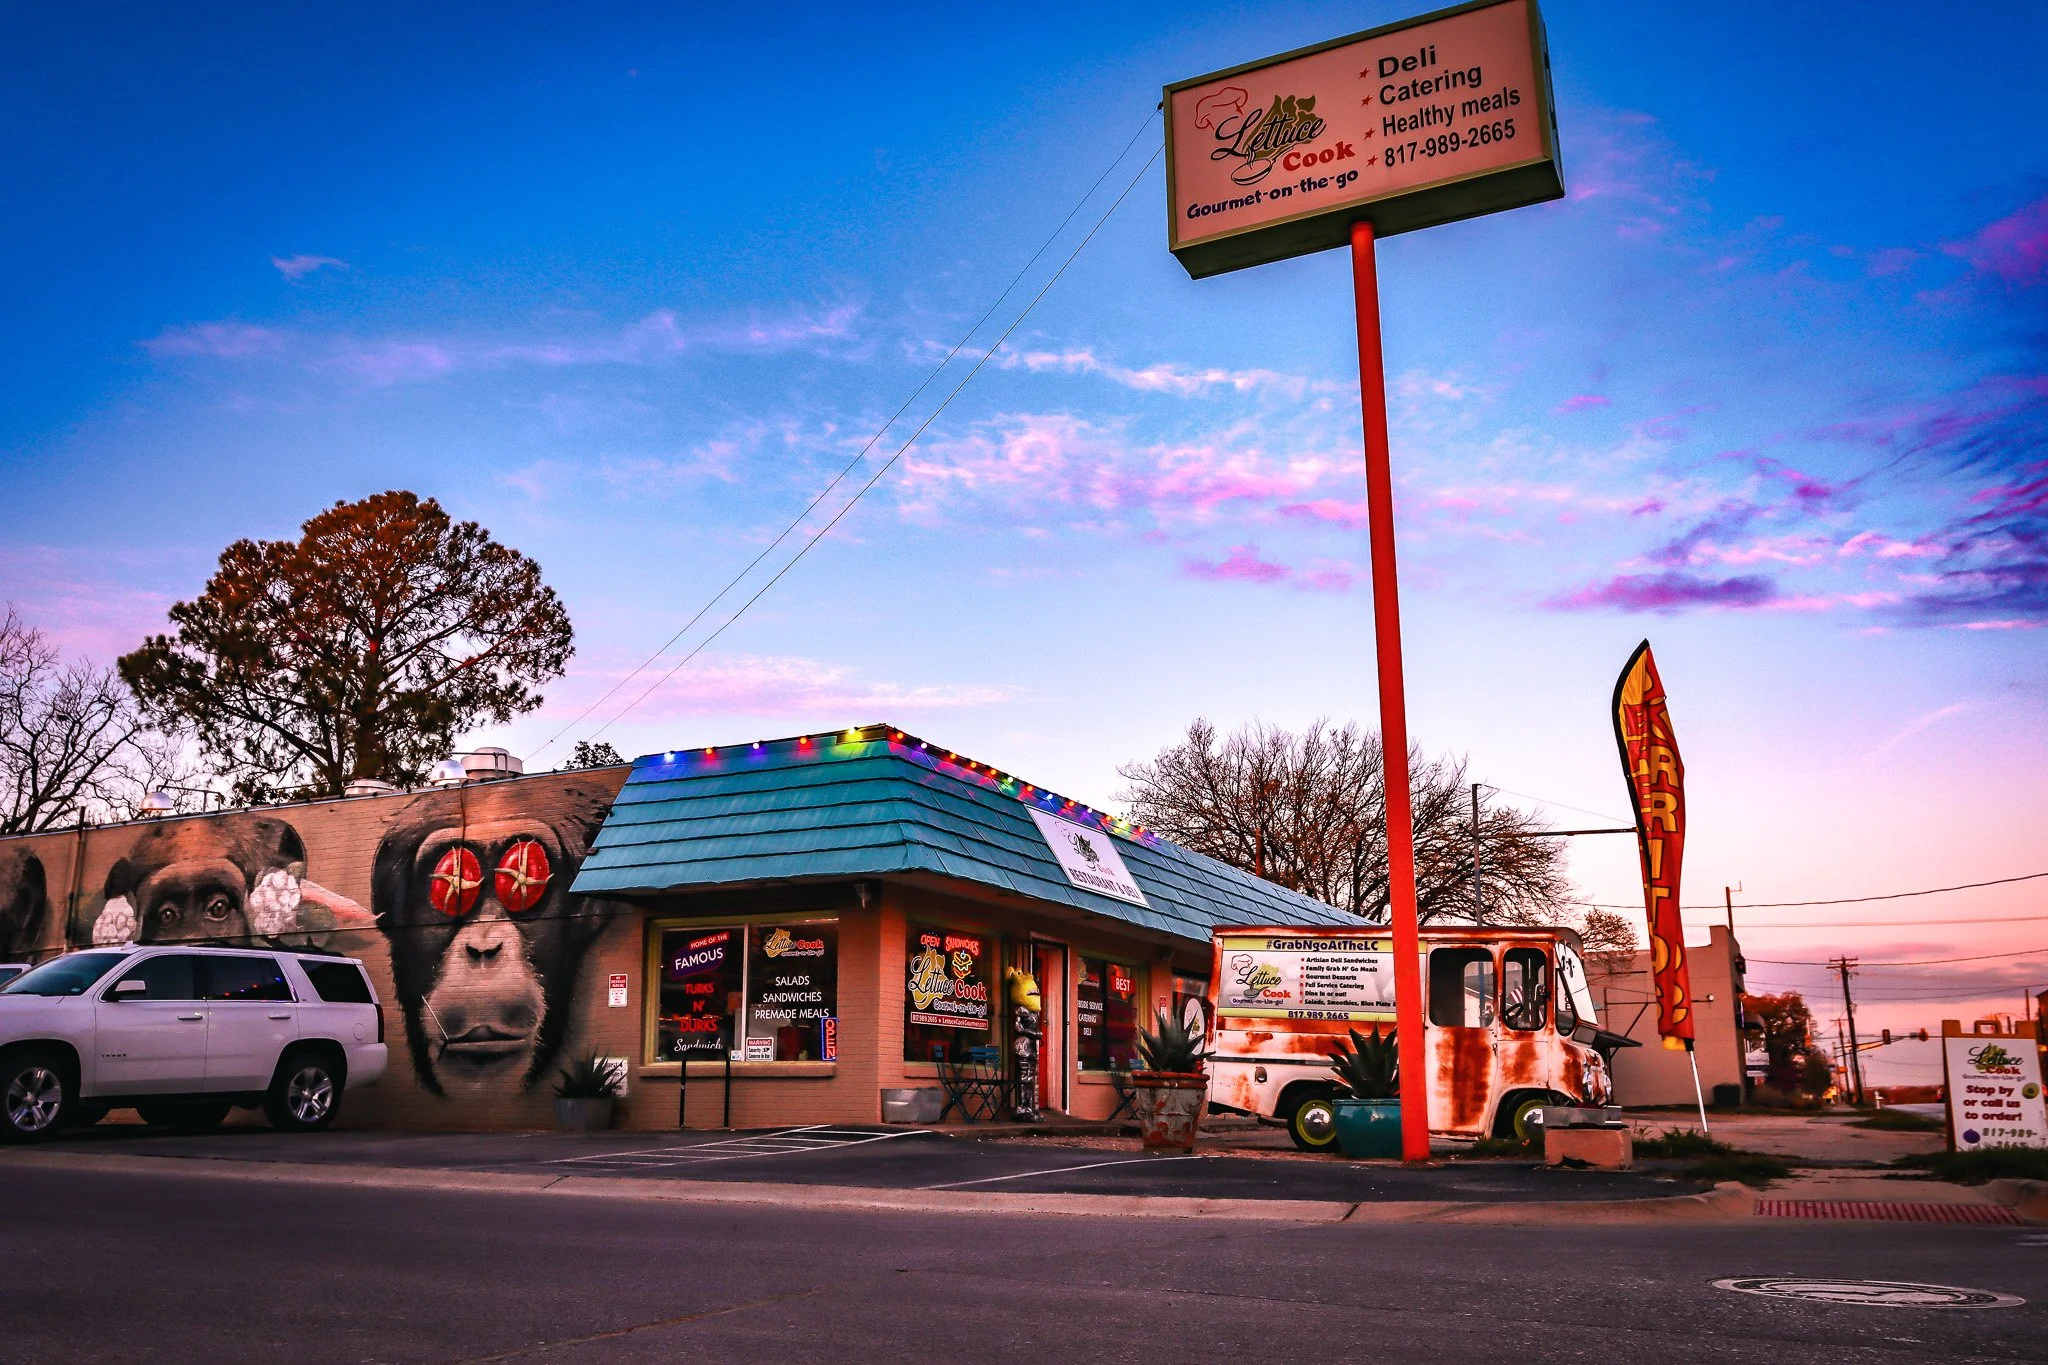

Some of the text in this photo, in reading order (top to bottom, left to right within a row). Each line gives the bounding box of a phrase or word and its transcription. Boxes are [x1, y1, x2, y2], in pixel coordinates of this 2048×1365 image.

[1378, 45, 1436, 78] Deli
[1380, 66, 1482, 105] Catering
[1383, 87, 1520, 136] Healthy meals
[1210, 108, 1327, 161] Lettuce
[1385, 118, 1515, 167] 817-989-2665
[1283, 141, 1355, 172] Cook
[1187, 169, 1359, 219] Gourmet-on-the-go
[1068, 867, 1118, 892] RESTAURANT
[1122, 884, 1141, 900] DELI
[690, 939, 707, 949] HOME
[717, 933, 728, 942] THE
[797, 938, 825, 950] Cook
[920, 934, 980, 956] OPEN SANDWICHES
[1266, 940, 1378, 952] #GrabNgoAtTheLC
[675, 947, 724, 970] FAMOUS
[1235, 965, 1282, 986] Lettuce
[1305, 965, 1324, 973] Family
[775, 975, 810, 987] SALADS
[908, 955, 987, 1002] Lettuce Cook
[1115, 977, 1131, 992] BEST
[685, 982, 715, 995] TURKS
[1262, 989, 1292, 999] Cook
[763, 991, 822, 1003] SANDWICHES
[755, 1008, 830, 1019] PREMADE MEALS
[1288, 1010, 1349, 1020] 817.989.2665
[825, 1019, 836, 1059] OPEN
[1986, 1065, 2021, 1075] Cook
[1966, 1085, 2015, 1097] Stop by
[1963, 1099, 2021, 1108] or call us
[1965, 1111, 1979, 1120] to
